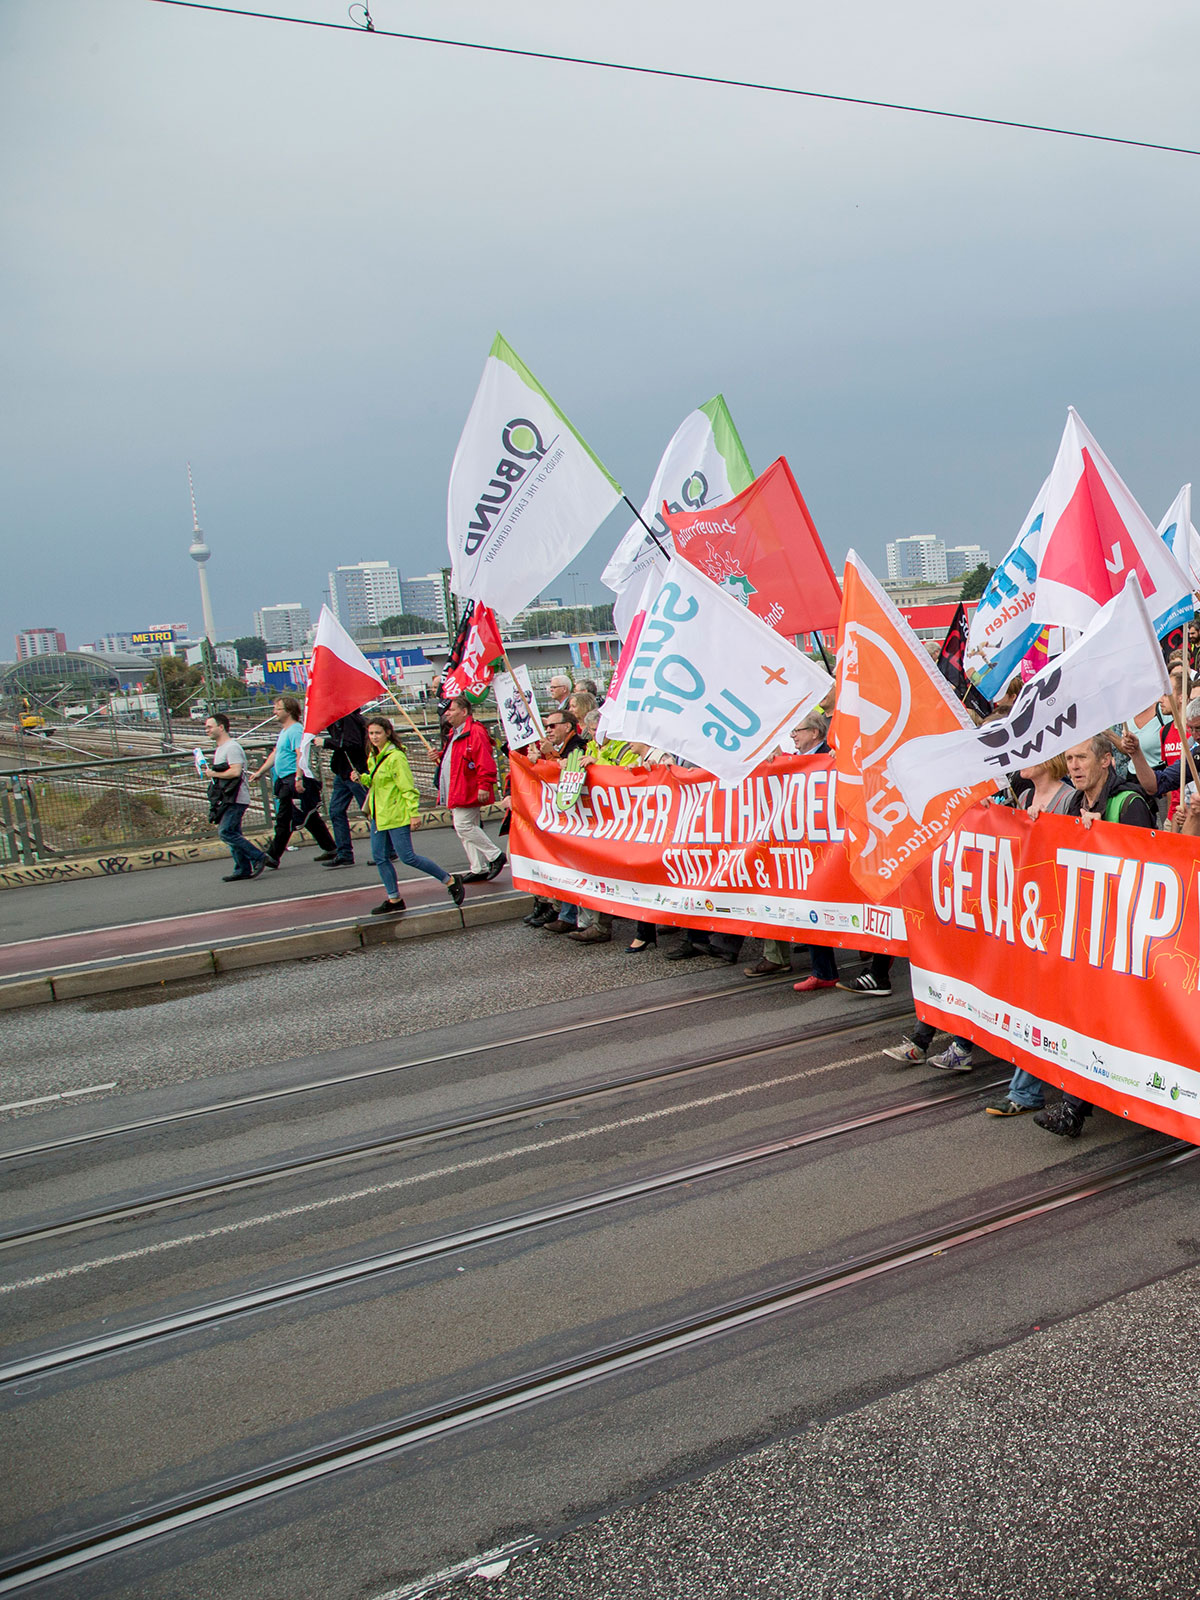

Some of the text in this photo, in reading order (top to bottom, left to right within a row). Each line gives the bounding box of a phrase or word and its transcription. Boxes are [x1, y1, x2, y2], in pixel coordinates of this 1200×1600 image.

[132, 632, 172, 643] METRO
[1164, 743, 1175, 752] PRO
[563, 770, 585, 783] STOP
[557, 782, 581, 794] CETA!
[662, 846, 815, 891] STATT CETA & TTIP
[931, 829, 1016, 944] CETA
[1020, 881, 1047, 953] &
[1056, 847, 1186, 980] TTIP
[866, 906, 891, 937] JETZT
[1043, 1036, 1059, 1051] Brot
[1093, 1066, 1110, 1079] NABU
